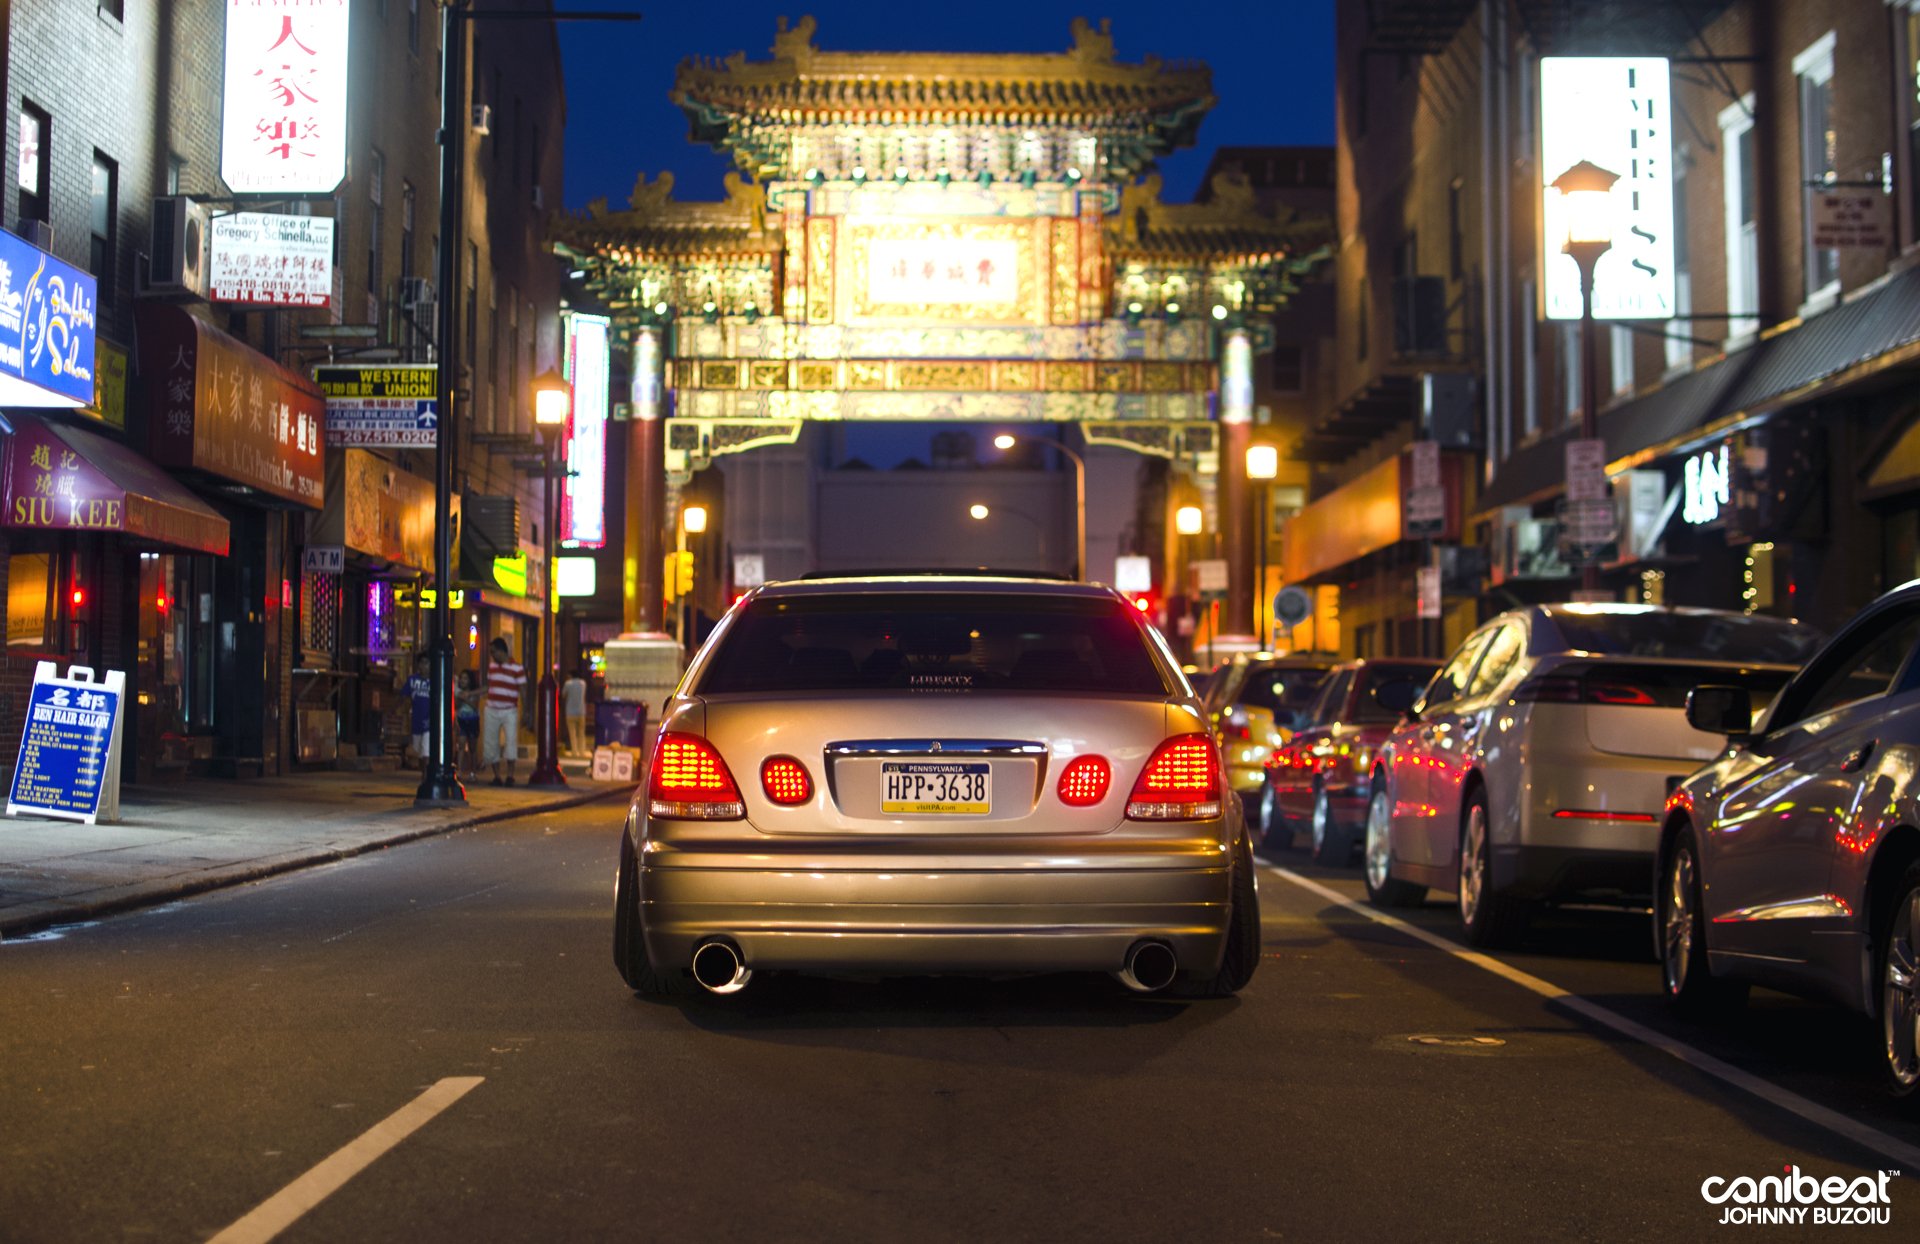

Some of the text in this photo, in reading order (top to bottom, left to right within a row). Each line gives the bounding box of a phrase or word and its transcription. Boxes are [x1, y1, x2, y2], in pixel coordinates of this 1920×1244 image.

[235, 214, 311, 230] Law Office of
[216, 224, 260, 242] Gregory
[217, 288, 326, 304] 109 N 10th St. 2nd Floor
[46, 315, 91, 381] Salon
[360, 370, 429, 383] WESTERN
[167, 344, 194, 436] 大家樂
[208, 354, 264, 433] 大家樂
[385, 384, 429, 396] UNION
[30, 444, 79, 471] 趙記
[15, 496, 55, 526] SIU
[68, 498, 121, 528] KEE
[308, 551, 339, 567] ATM
[45, 688, 106, 711] 名都
[33, 707, 52, 722] BEN
[53, 709, 78, 727] HAIR
[78, 714, 110, 730] SALON
[908, 765, 964, 773] PENNSYLVANIA
[33, 785, 63, 794] TREATMENT
[31, 796, 56, 805] STRAIGHT
[916, 804, 956, 812] visitPA.com
